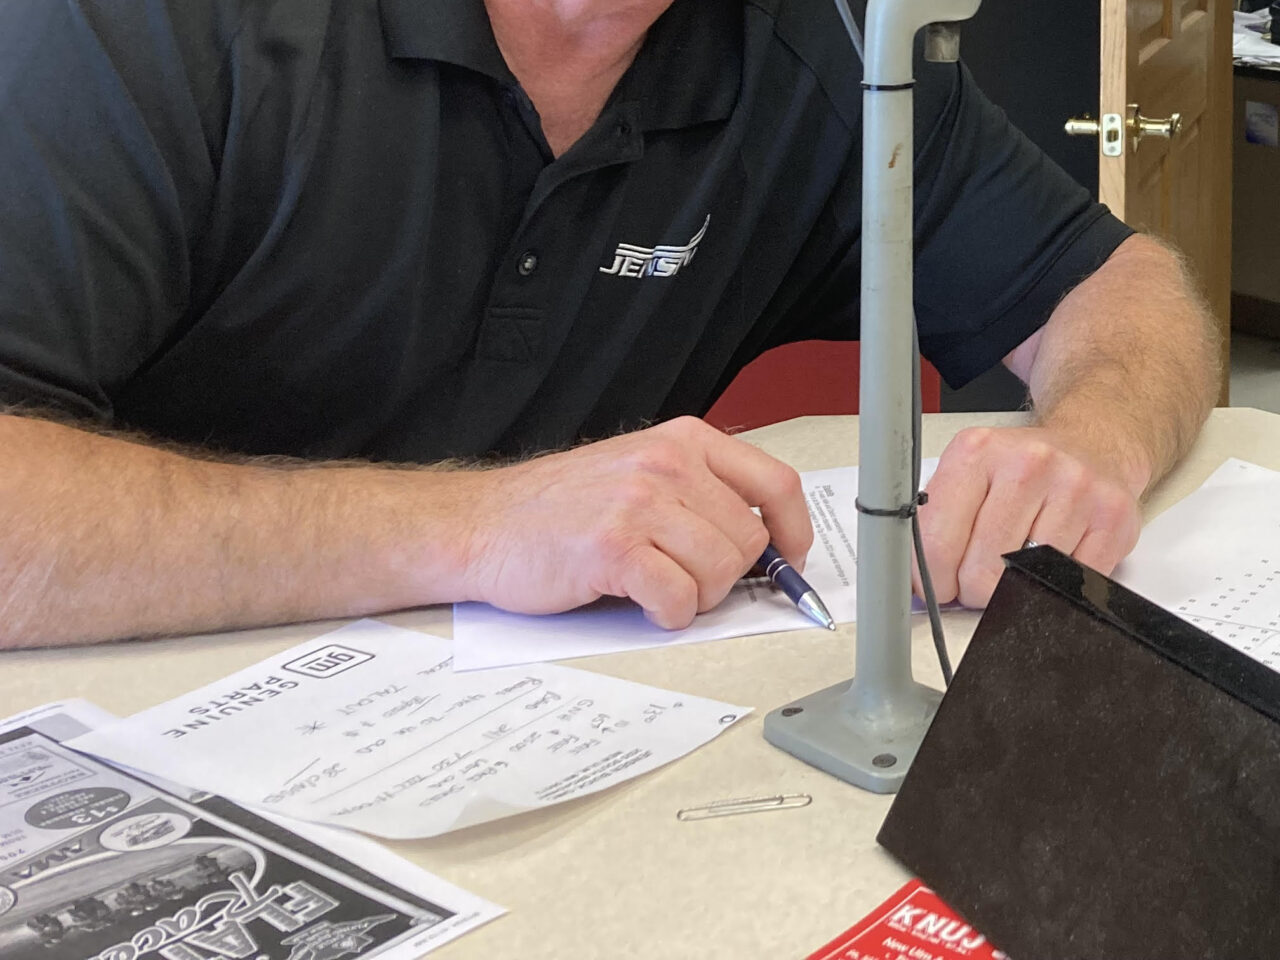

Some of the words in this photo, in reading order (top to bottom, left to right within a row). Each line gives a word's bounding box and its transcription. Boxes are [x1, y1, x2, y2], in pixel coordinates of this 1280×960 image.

[306, 651, 355, 673] gm
[162, 679, 300, 739] GENUINE
[188, 675, 275, 716] PARTS
[889, 903, 986, 950] KNUJ
